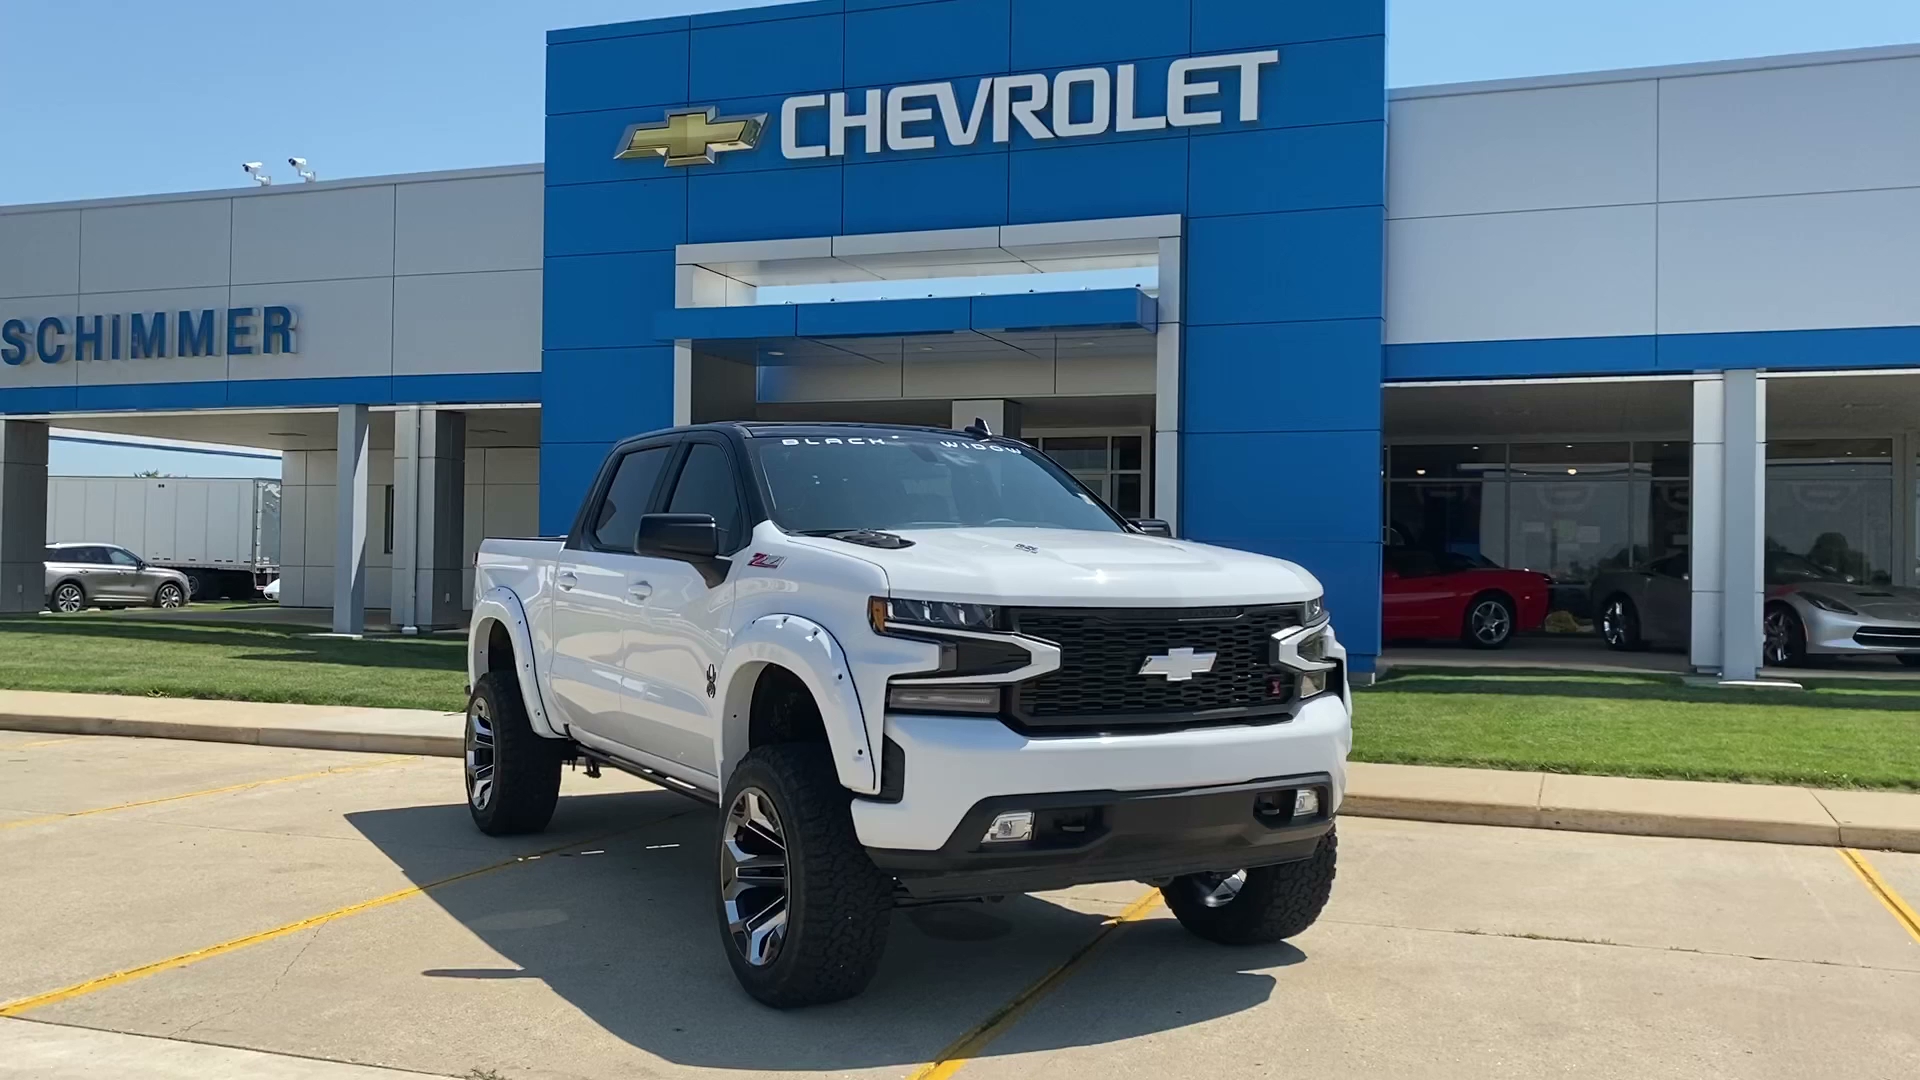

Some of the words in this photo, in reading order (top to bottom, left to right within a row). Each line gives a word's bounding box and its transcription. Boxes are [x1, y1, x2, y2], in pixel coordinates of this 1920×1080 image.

[780, 49, 1279, 160] CHEVROLET
[1, 305, 297, 366] SCHIMMER
[781, 437, 886, 446] BLACK
[939, 440, 1022, 455] WIDOW
